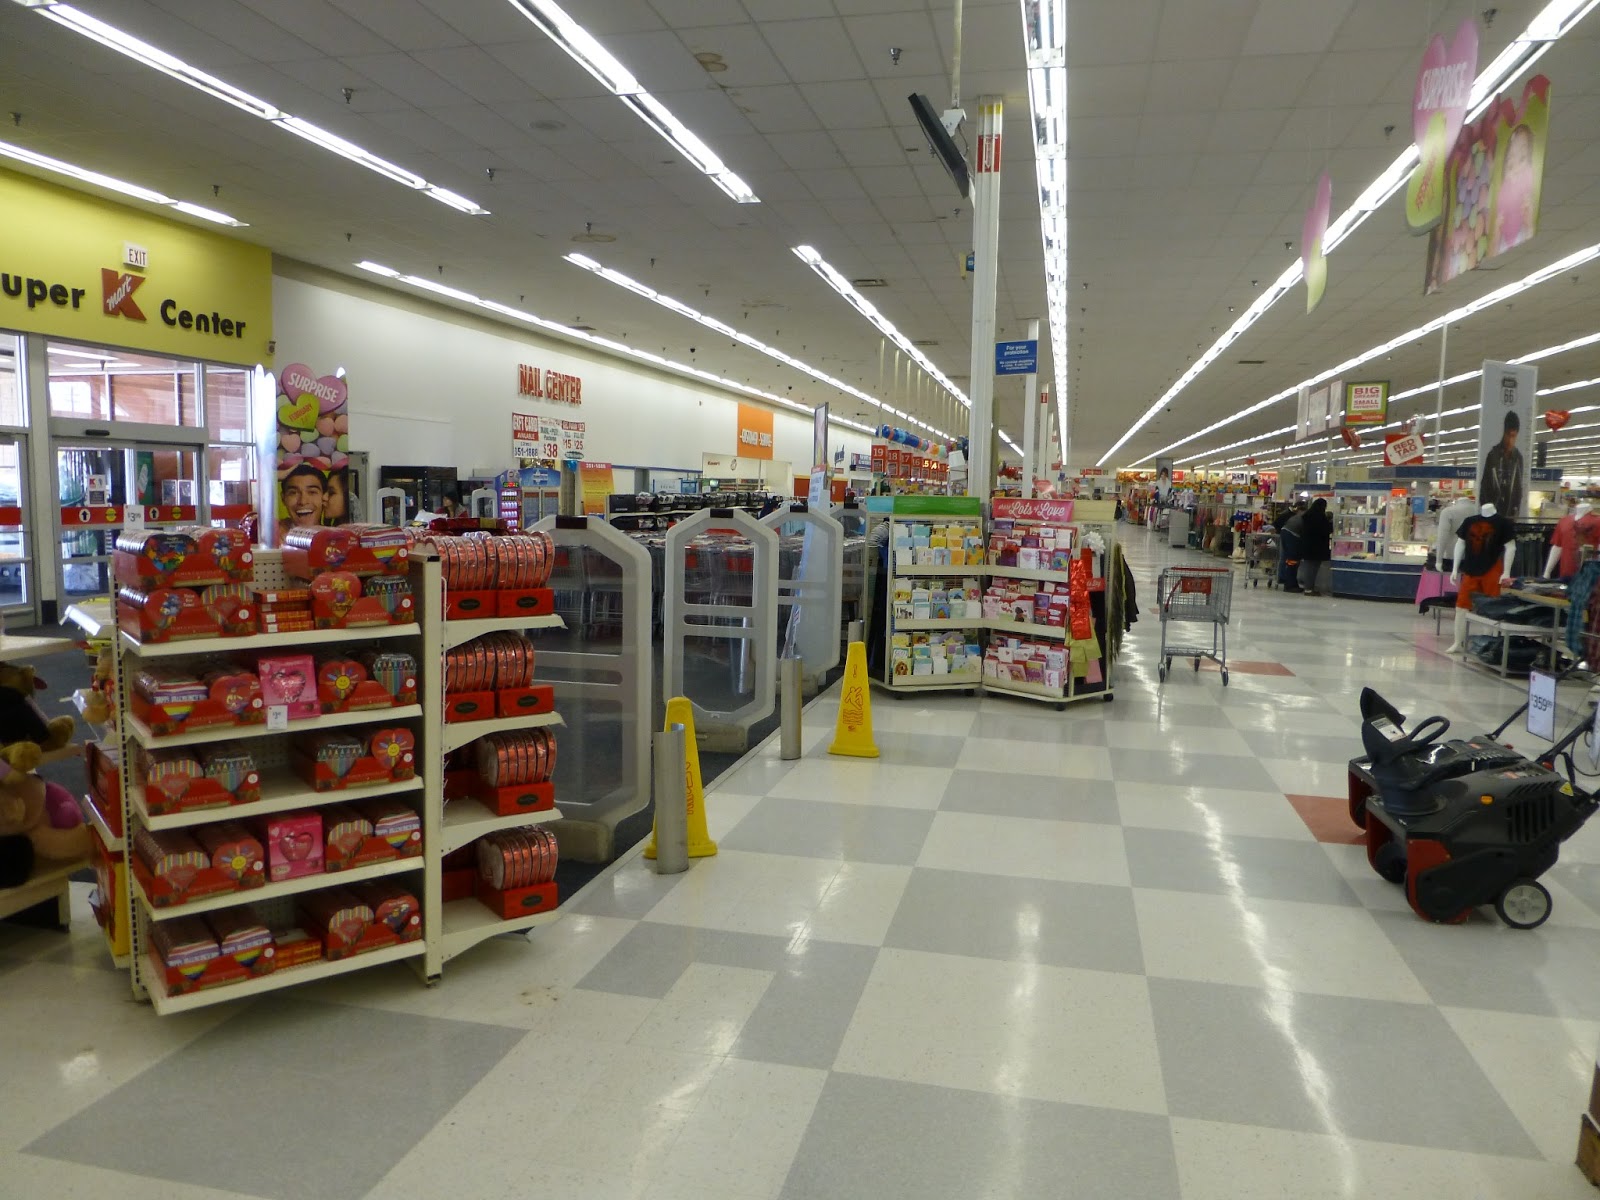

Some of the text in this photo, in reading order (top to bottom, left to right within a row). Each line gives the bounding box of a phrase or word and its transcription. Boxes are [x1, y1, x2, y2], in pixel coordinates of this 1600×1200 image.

[1417, 61, 1468, 110] SURPRISE
[128, 248, 147, 266] EXIT
[160, 299, 247, 339] Center
[287, 372, 339, 403] SURPRISE
[518, 364, 582, 405] NAIL CENTER
[543, 443, 558, 458] $38
[873, 448, 884, 457] 19
[1393, 439, 1415, 451] RED
[1395, 445, 1418, 457] TAG
[888, 452, 898, 460] 18
[1009, 502, 1033, 518] Lots
[1037, 502, 1065, 520] Love
